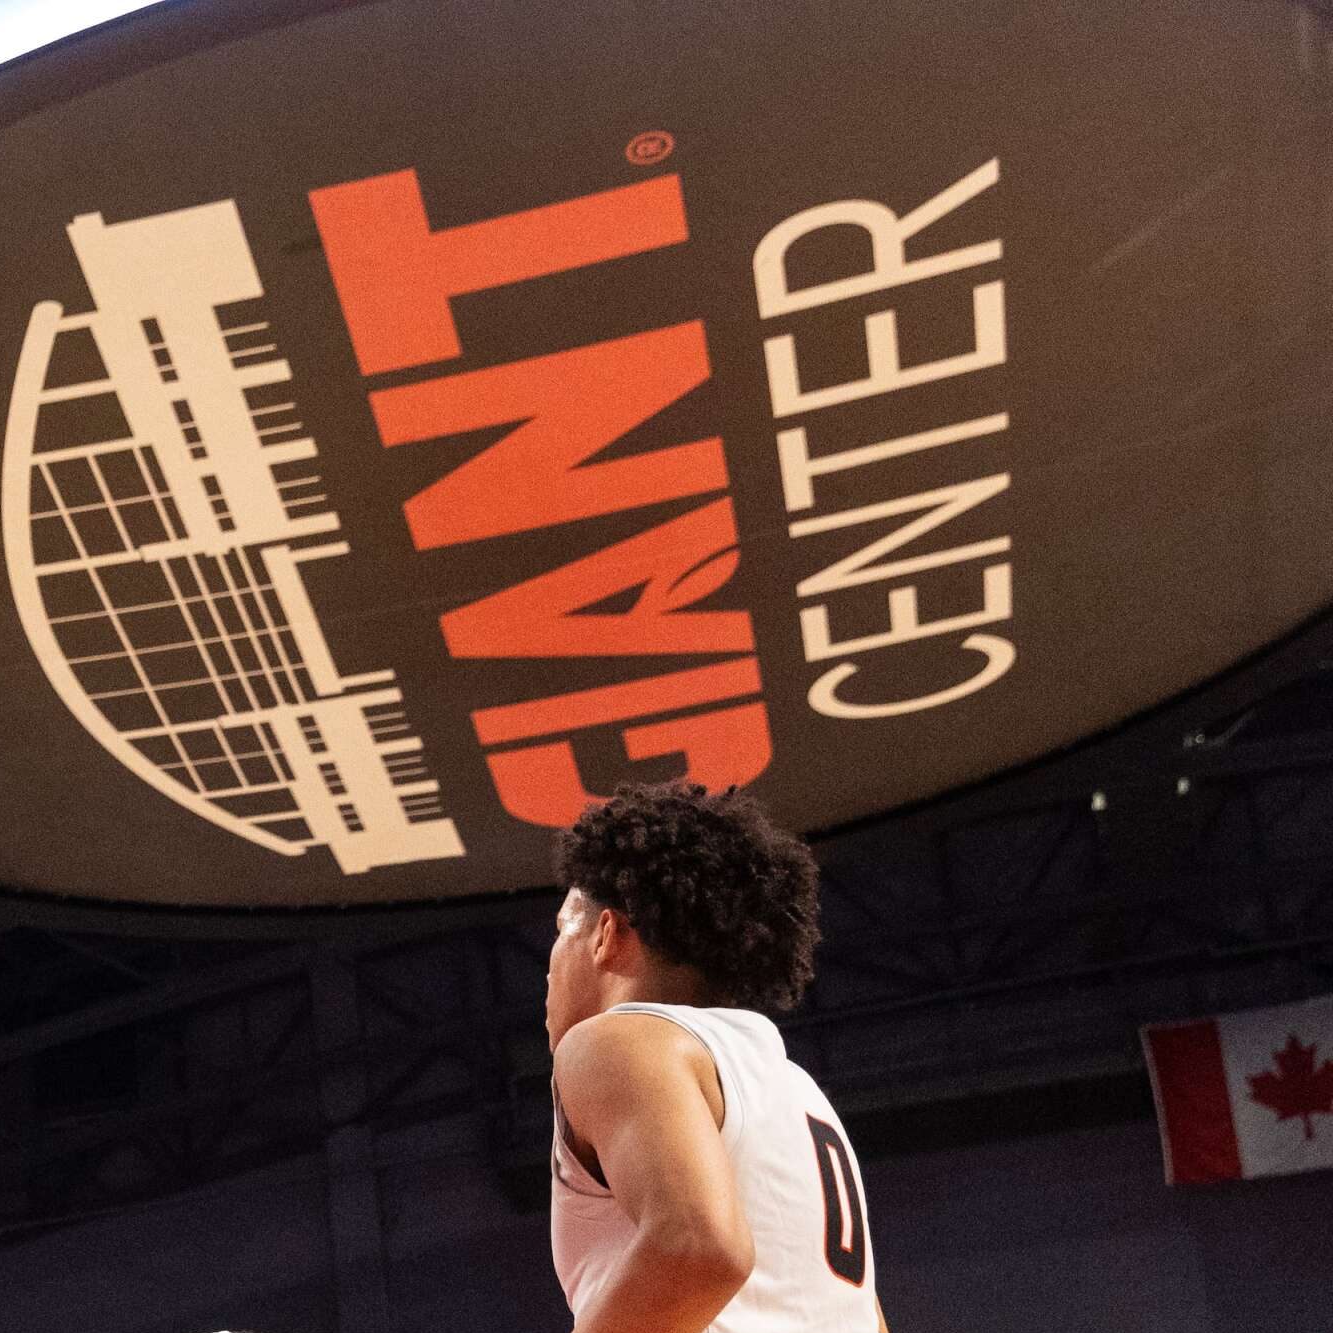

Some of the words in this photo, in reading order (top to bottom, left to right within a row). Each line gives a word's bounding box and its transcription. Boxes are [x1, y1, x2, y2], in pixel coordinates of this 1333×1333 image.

[308, 168, 773, 828] GIANT
[751, 157, 1016, 720] CENTER
[805, 1112, 868, 1288] 0
